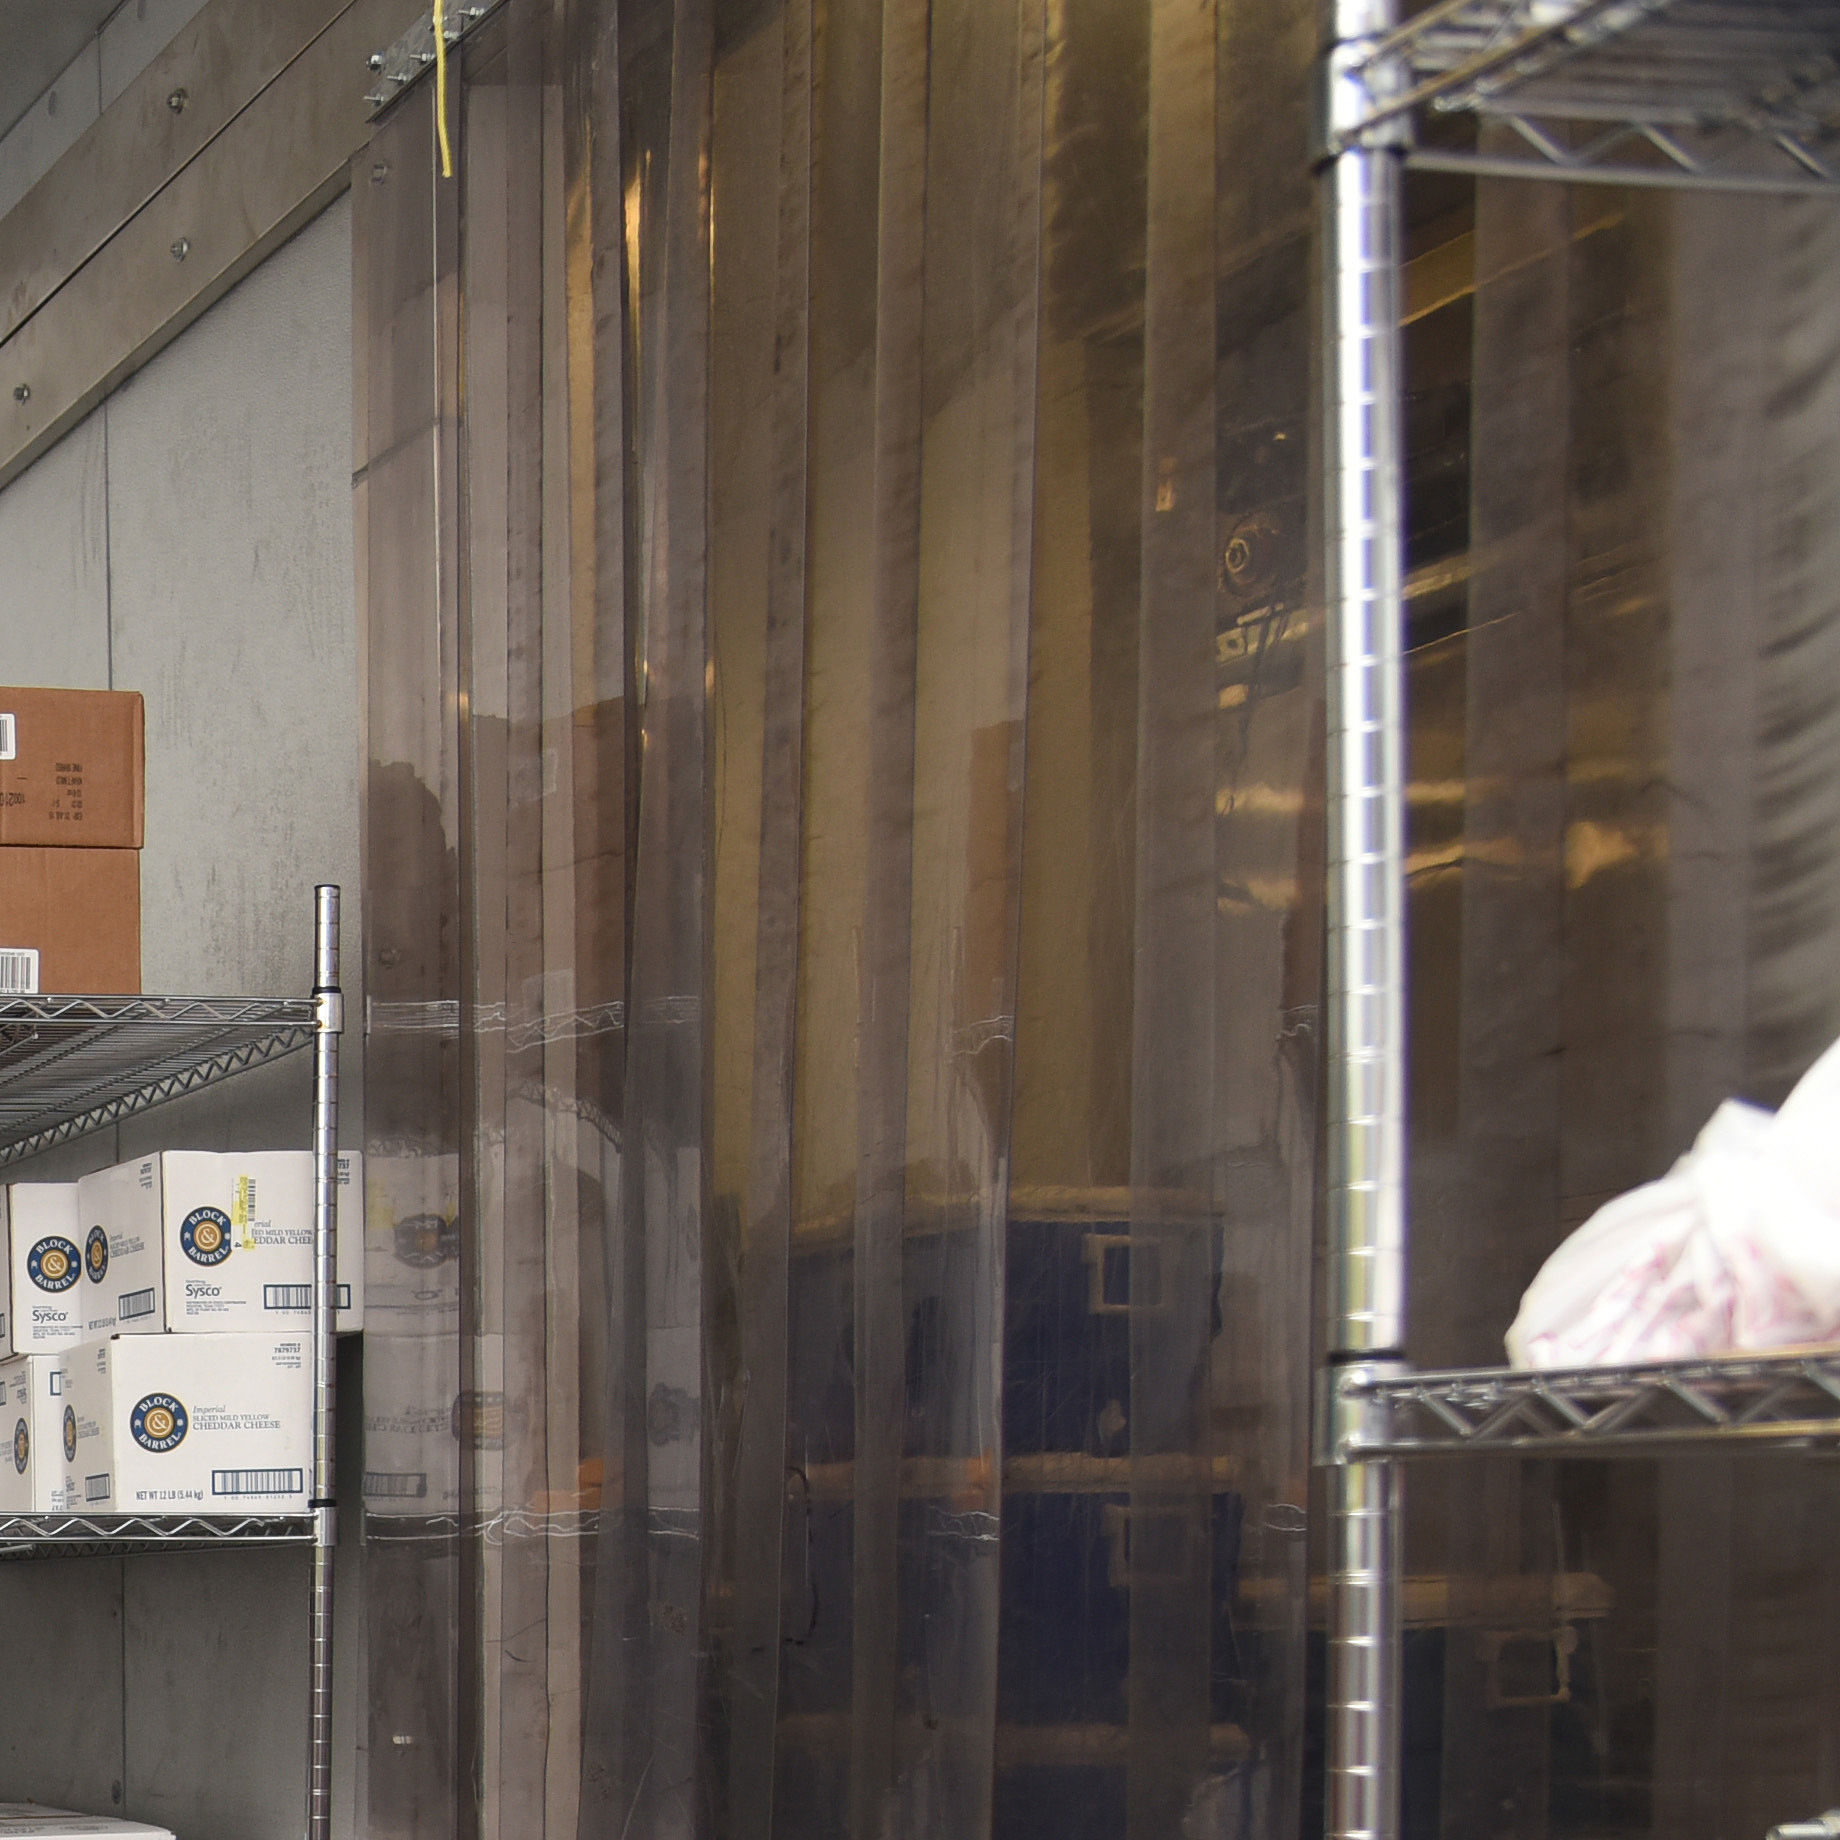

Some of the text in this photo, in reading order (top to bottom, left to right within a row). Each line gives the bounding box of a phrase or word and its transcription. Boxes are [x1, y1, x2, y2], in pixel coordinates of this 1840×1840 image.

[188, 1209, 227, 1226] BLOCK
[35, 1239, 74, 1255] BLOCK
[188, 1245, 230, 1263] BARREL
[34, 1273, 75, 1290] BARREL
[185, 1284, 222, 1299] Sysco
[32, 1309, 68, 1324] Sysco
[138, 1396, 179, 1413] BLOCK
[192, 1405, 226, 1414] Imperial
[192, 1420, 281, 1430] CHEDDAR CHEESE
[137, 1432, 182, 1450] BARREL
[136, 1491, 148, 1500] NET
[149, 1491, 159, 1500] WT
[167, 1491, 176, 1500] LB
[193, 1490, 204, 1500] kg)
